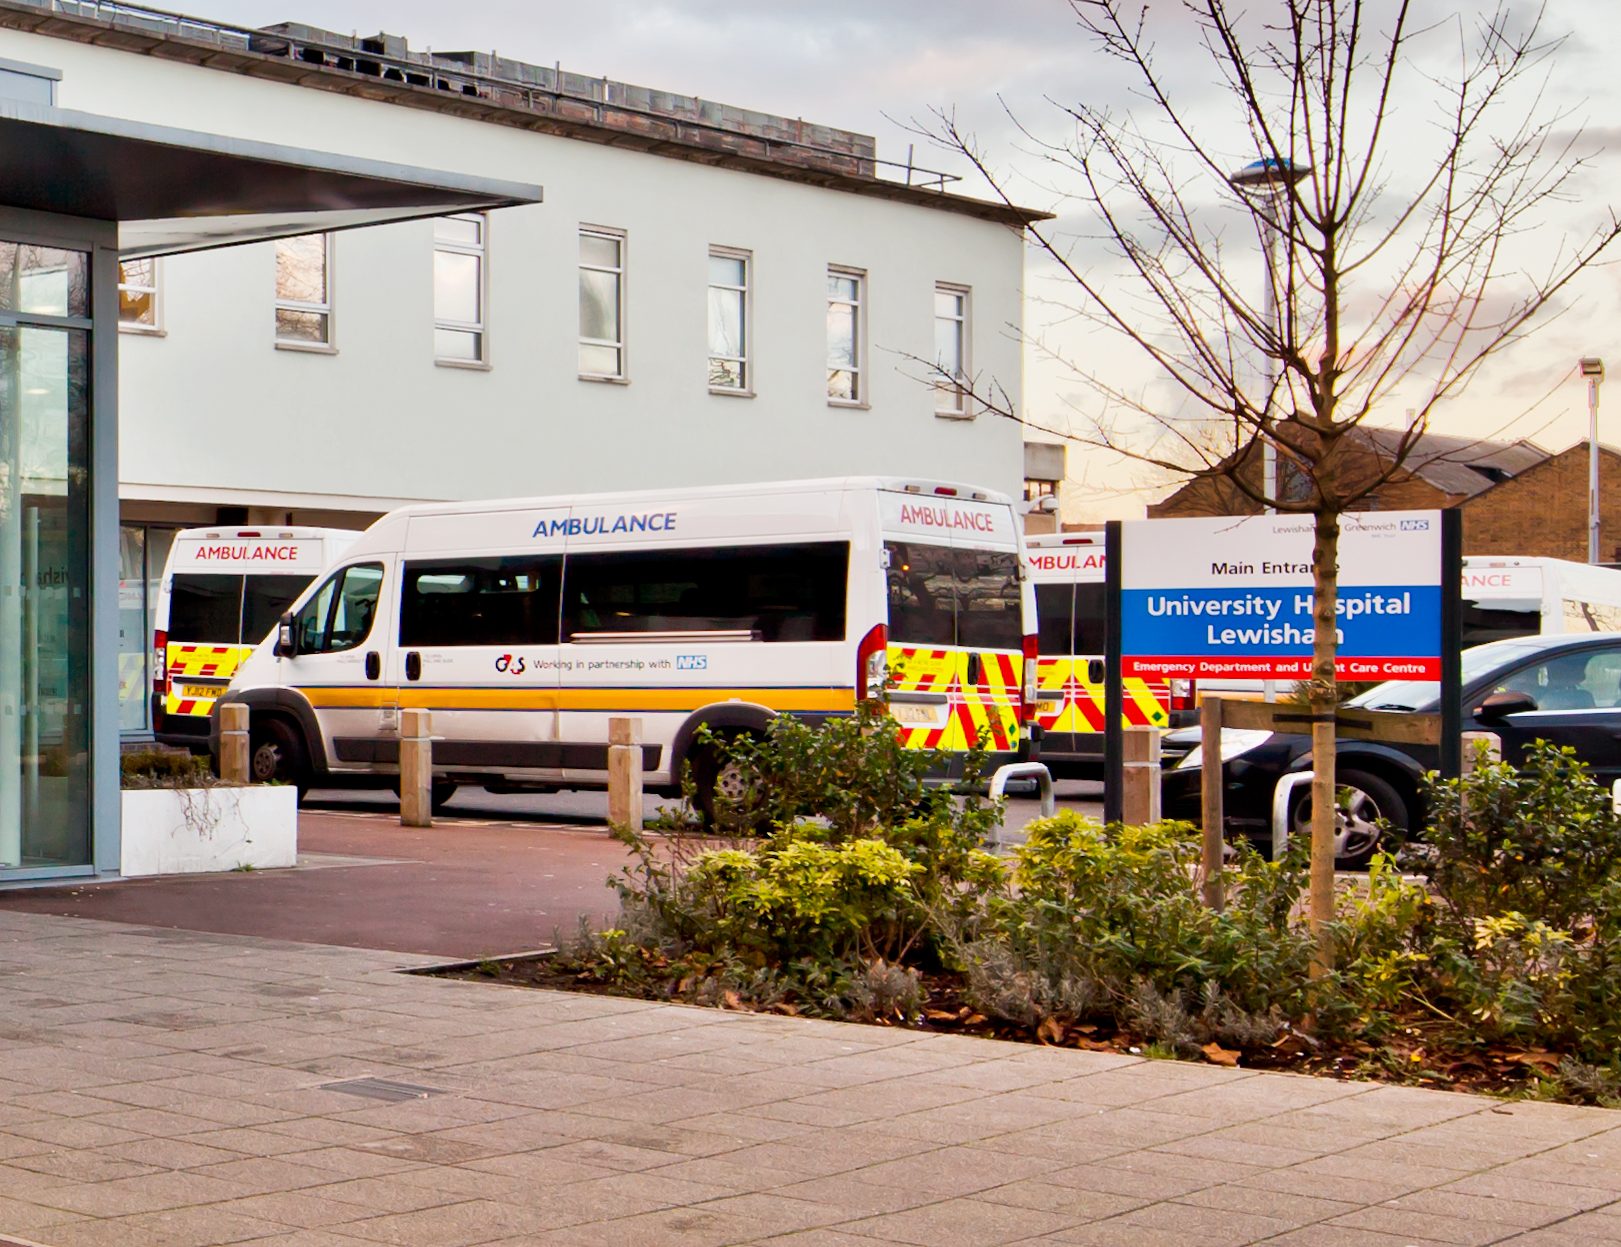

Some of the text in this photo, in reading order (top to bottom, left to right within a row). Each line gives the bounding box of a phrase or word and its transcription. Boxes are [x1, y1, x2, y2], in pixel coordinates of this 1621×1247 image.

[532, 512, 677, 538] AMBULANCE
[901, 504, 994, 533] AMBULANCE
[1400, 520, 1429, 531] NHS
[1273, 522, 1397, 534] Lewisha Greenwich
[195, 546, 298, 561] AMBULANCE
[1029, 554, 1106, 570] MBULA
[1211, 561, 1254, 575] Main
[1461, 574, 1512, 588] ANCE
[1147, 592, 1410, 621] University Hspital
[534, 659, 671, 671] Working in partnership with
[677, 655, 707, 670] NHS
[1133, 661, 1195, 673] Emergency
[1200, 661, 1271, 673] Department
[1276, 661, 1298, 672] and
[1350, 663, 1378, 673] Care
[1383, 663, 1426, 673] Centre
